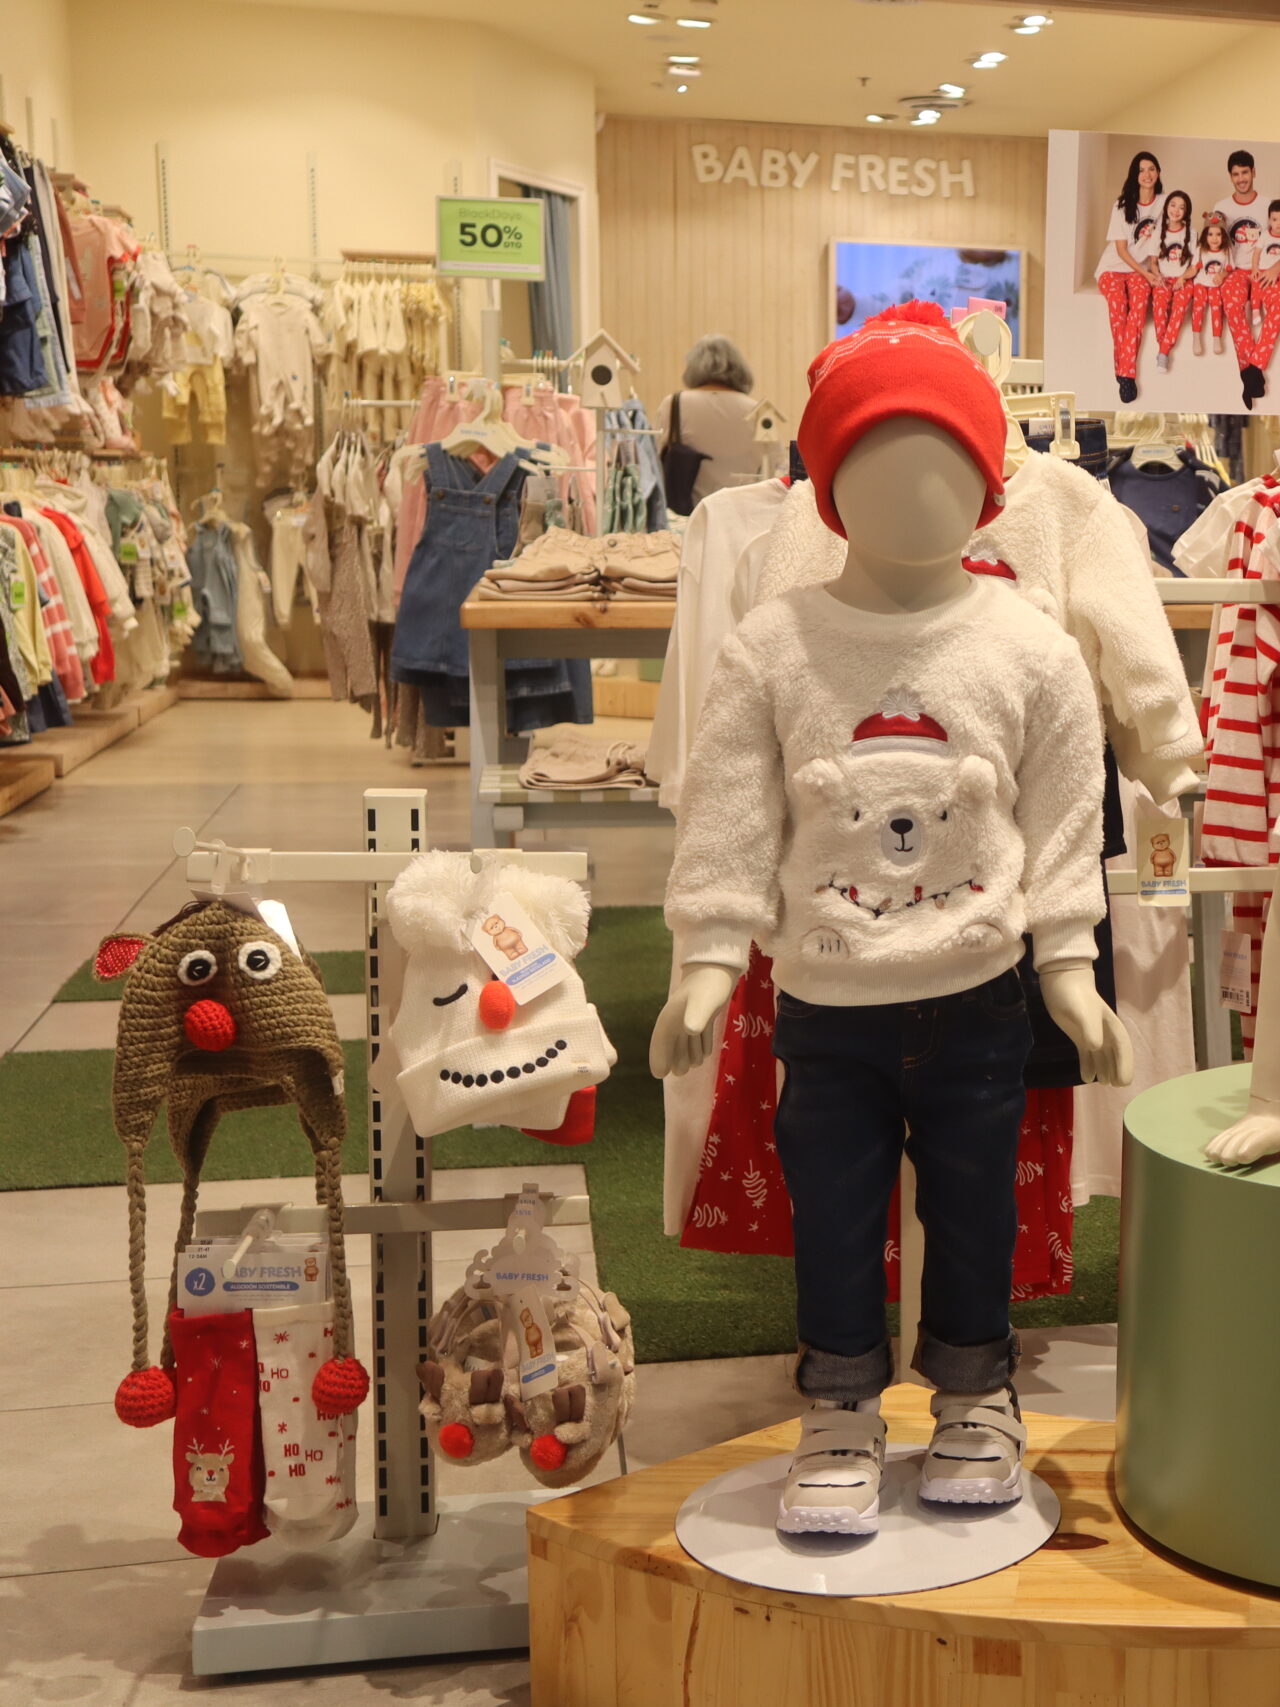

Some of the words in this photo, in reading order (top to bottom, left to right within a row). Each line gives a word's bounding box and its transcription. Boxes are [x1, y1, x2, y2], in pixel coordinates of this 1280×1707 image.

[691, 143, 820, 189] BABY
[831, 152, 976, 198] FRESH
[458, 221, 523, 248] 50%
[503, 241, 523, 249] DTO
[220, 1265, 256, 1279] ABY
[260, 1266, 302, 1279] FRESH
[496, 1271, 518, 1281] BABY
[520, 1272, 549, 1282] FRESH
[192, 1272, 206, 1290] x2
[271, 1367, 289, 1380] HO
[284, 1443, 300, 1458] HO
[304, 1449, 323, 1462] HO
[288, 1463, 306, 1478] HO
